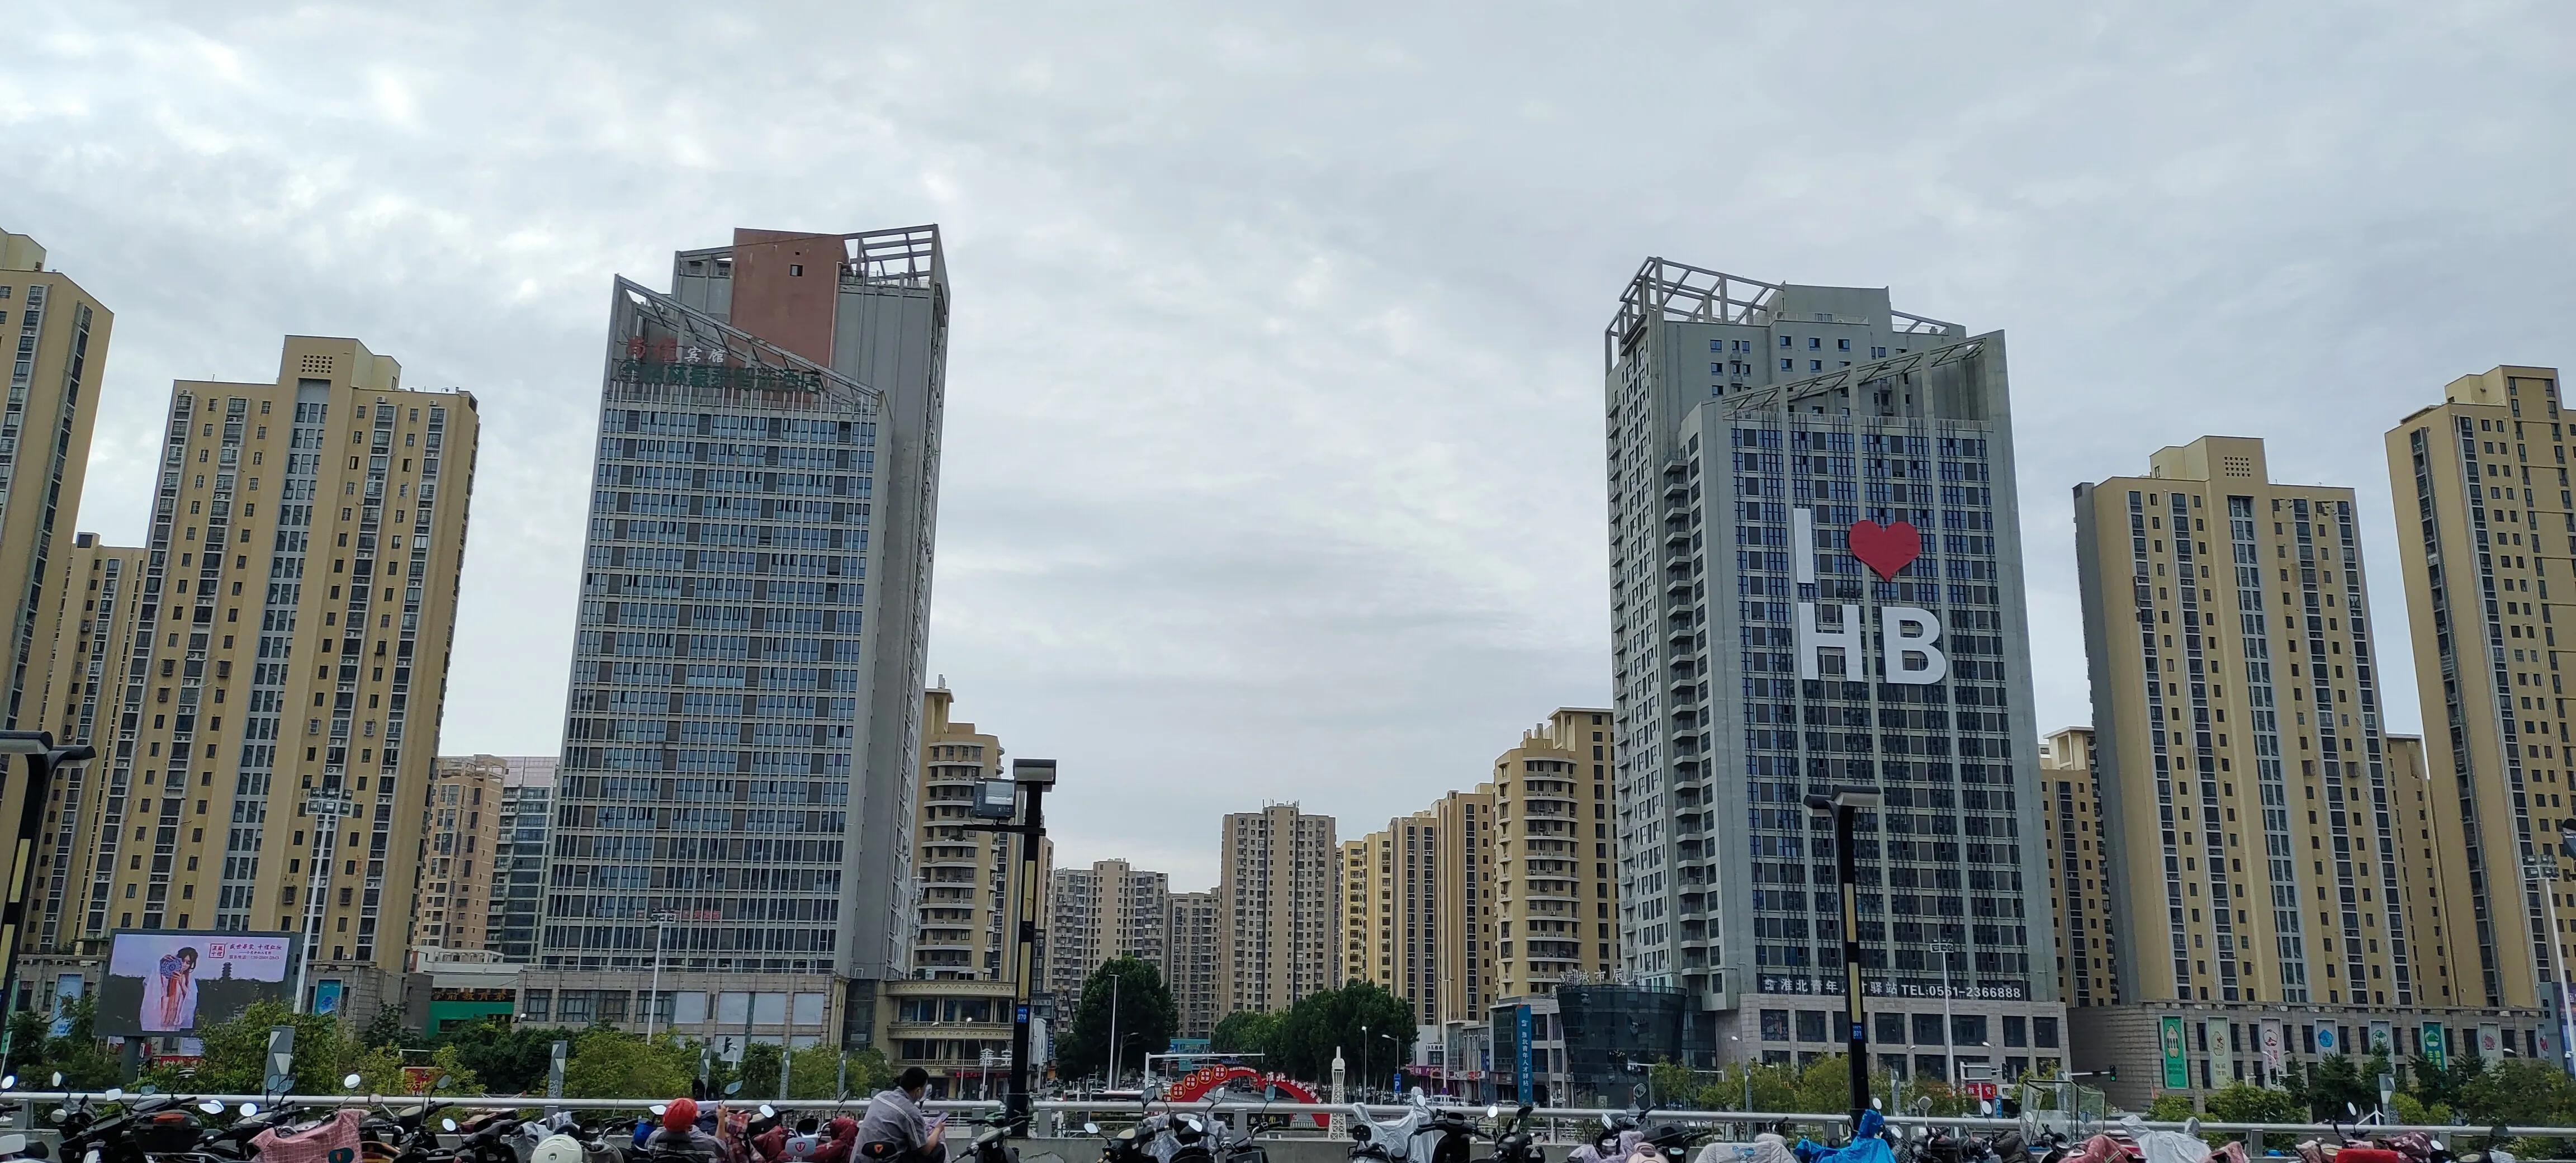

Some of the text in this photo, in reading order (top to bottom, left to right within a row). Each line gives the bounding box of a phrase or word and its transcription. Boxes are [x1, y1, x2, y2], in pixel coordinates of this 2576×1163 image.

[1793, 508, 1815, 584] I
[1798, 602, 1947, 685] HB
[1780, 978, 1897, 995] 淮北青年驿站
